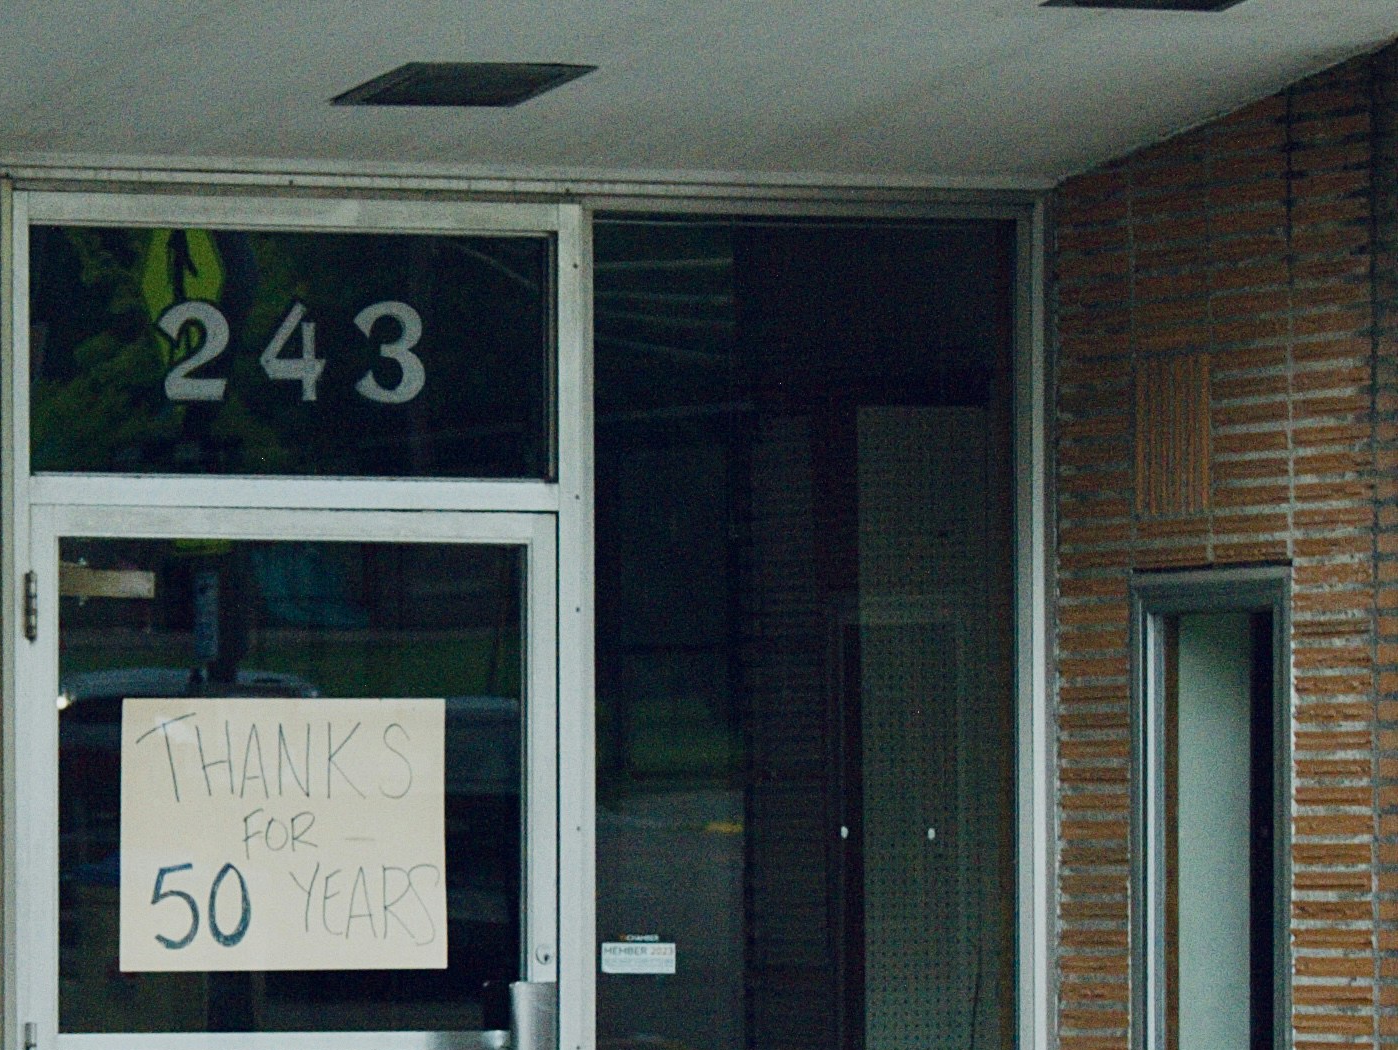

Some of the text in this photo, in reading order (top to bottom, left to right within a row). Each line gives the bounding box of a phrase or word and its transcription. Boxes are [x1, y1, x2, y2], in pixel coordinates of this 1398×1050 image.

[158, 300, 427, 403] 243
[135, 711, 413, 802] THANKS
[242, 807, 318, 860] FOR
[151, 862, 441, 950] 50 YEARS
[603, 946, 648, 956] MEMBER
